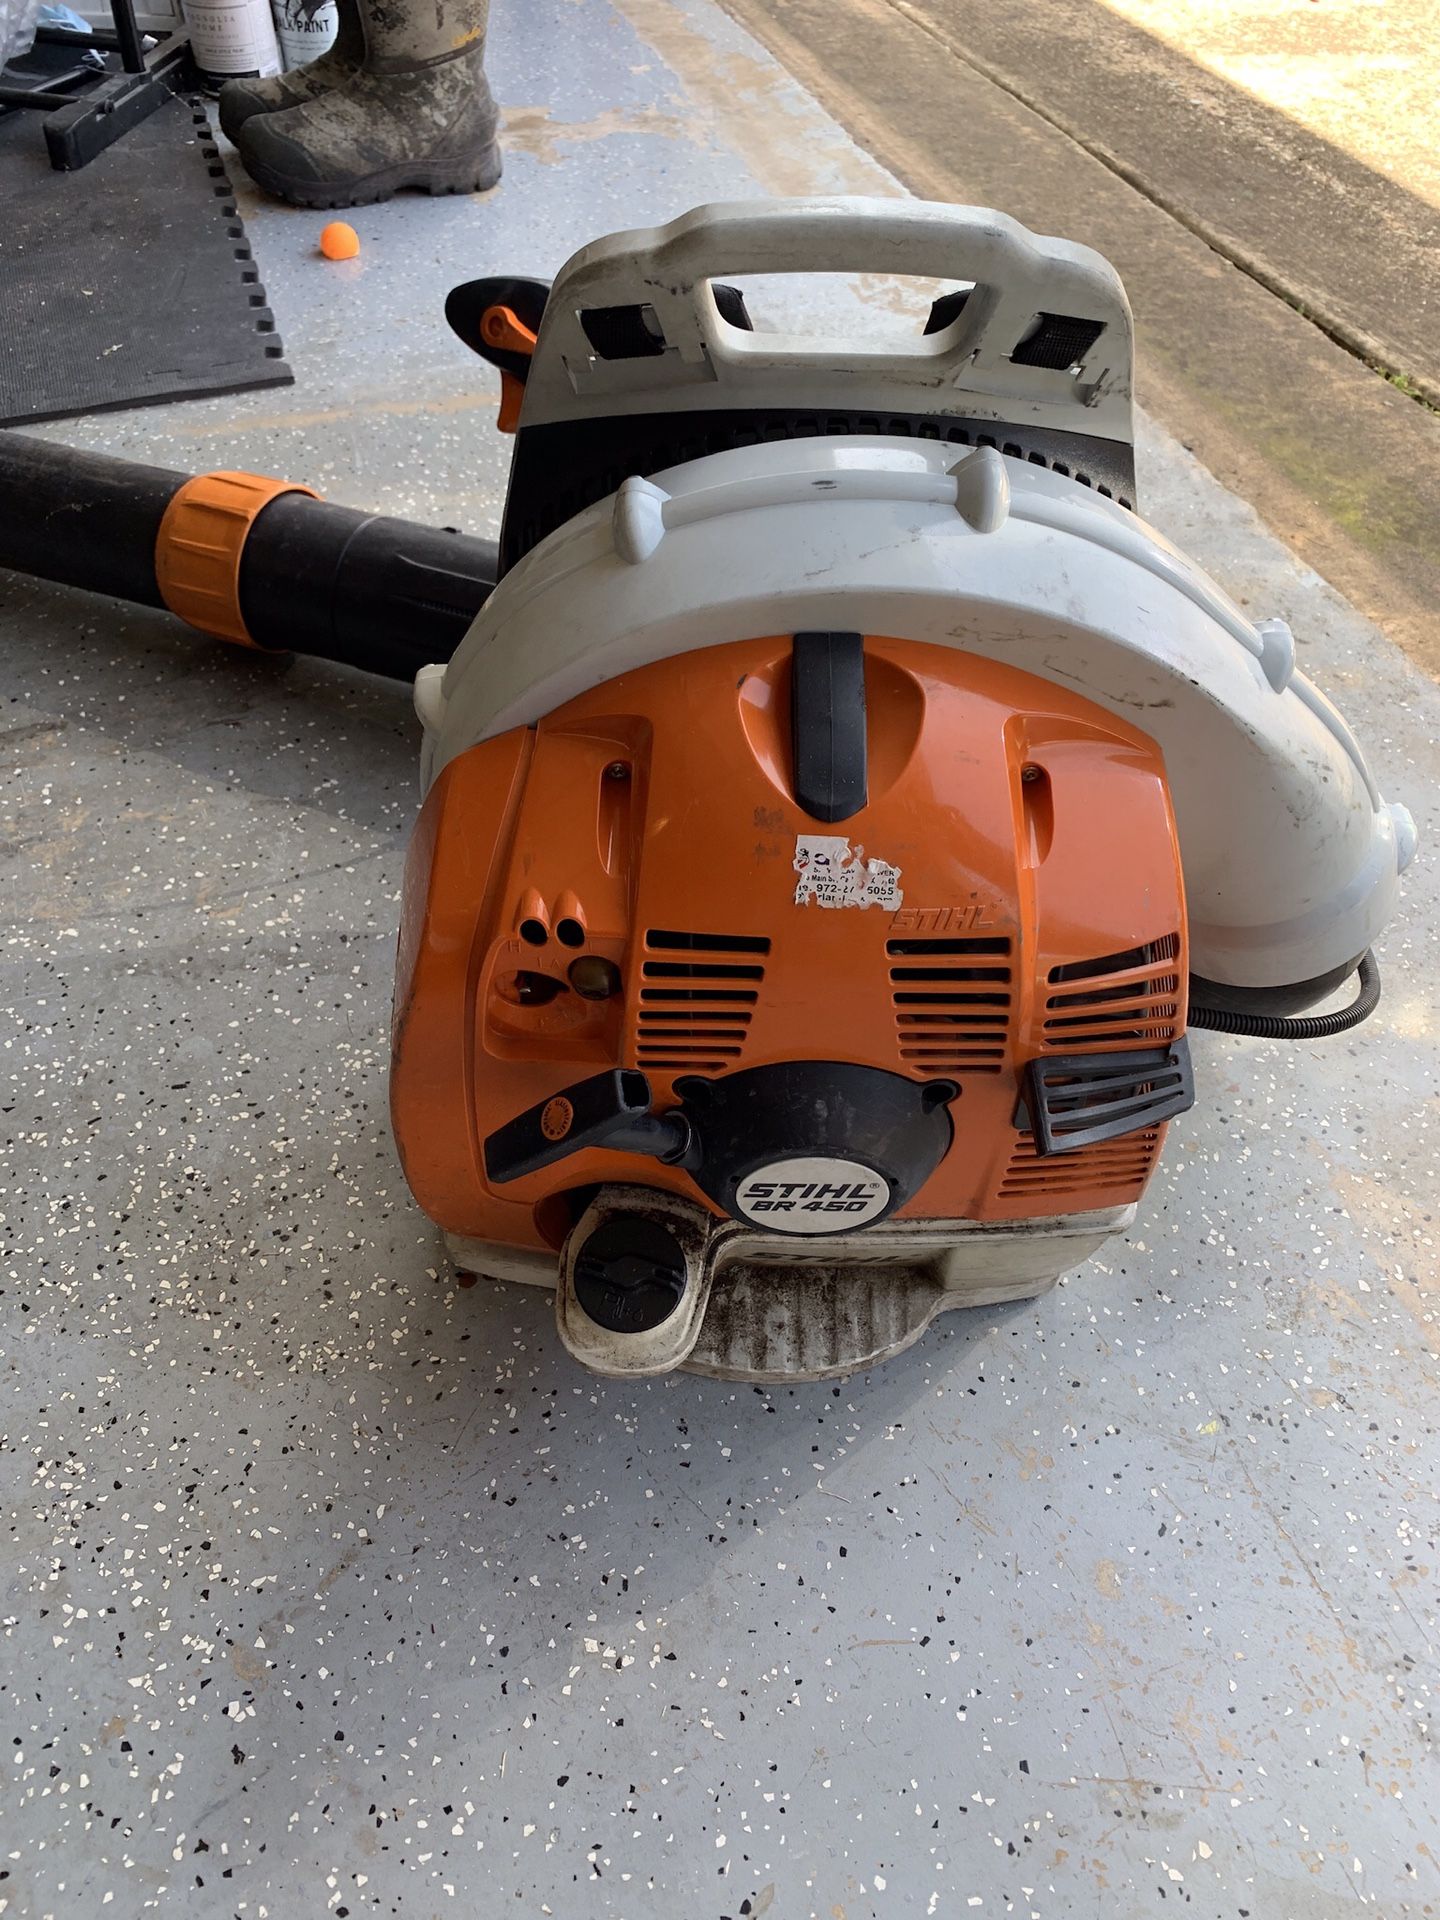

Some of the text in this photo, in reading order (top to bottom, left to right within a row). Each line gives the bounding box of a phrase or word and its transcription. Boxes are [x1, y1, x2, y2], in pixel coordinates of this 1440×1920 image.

[296, 19, 329, 33] PAINT
[889, 905, 994, 931] STIHL
[750, 1201, 868, 1212] BR 450
